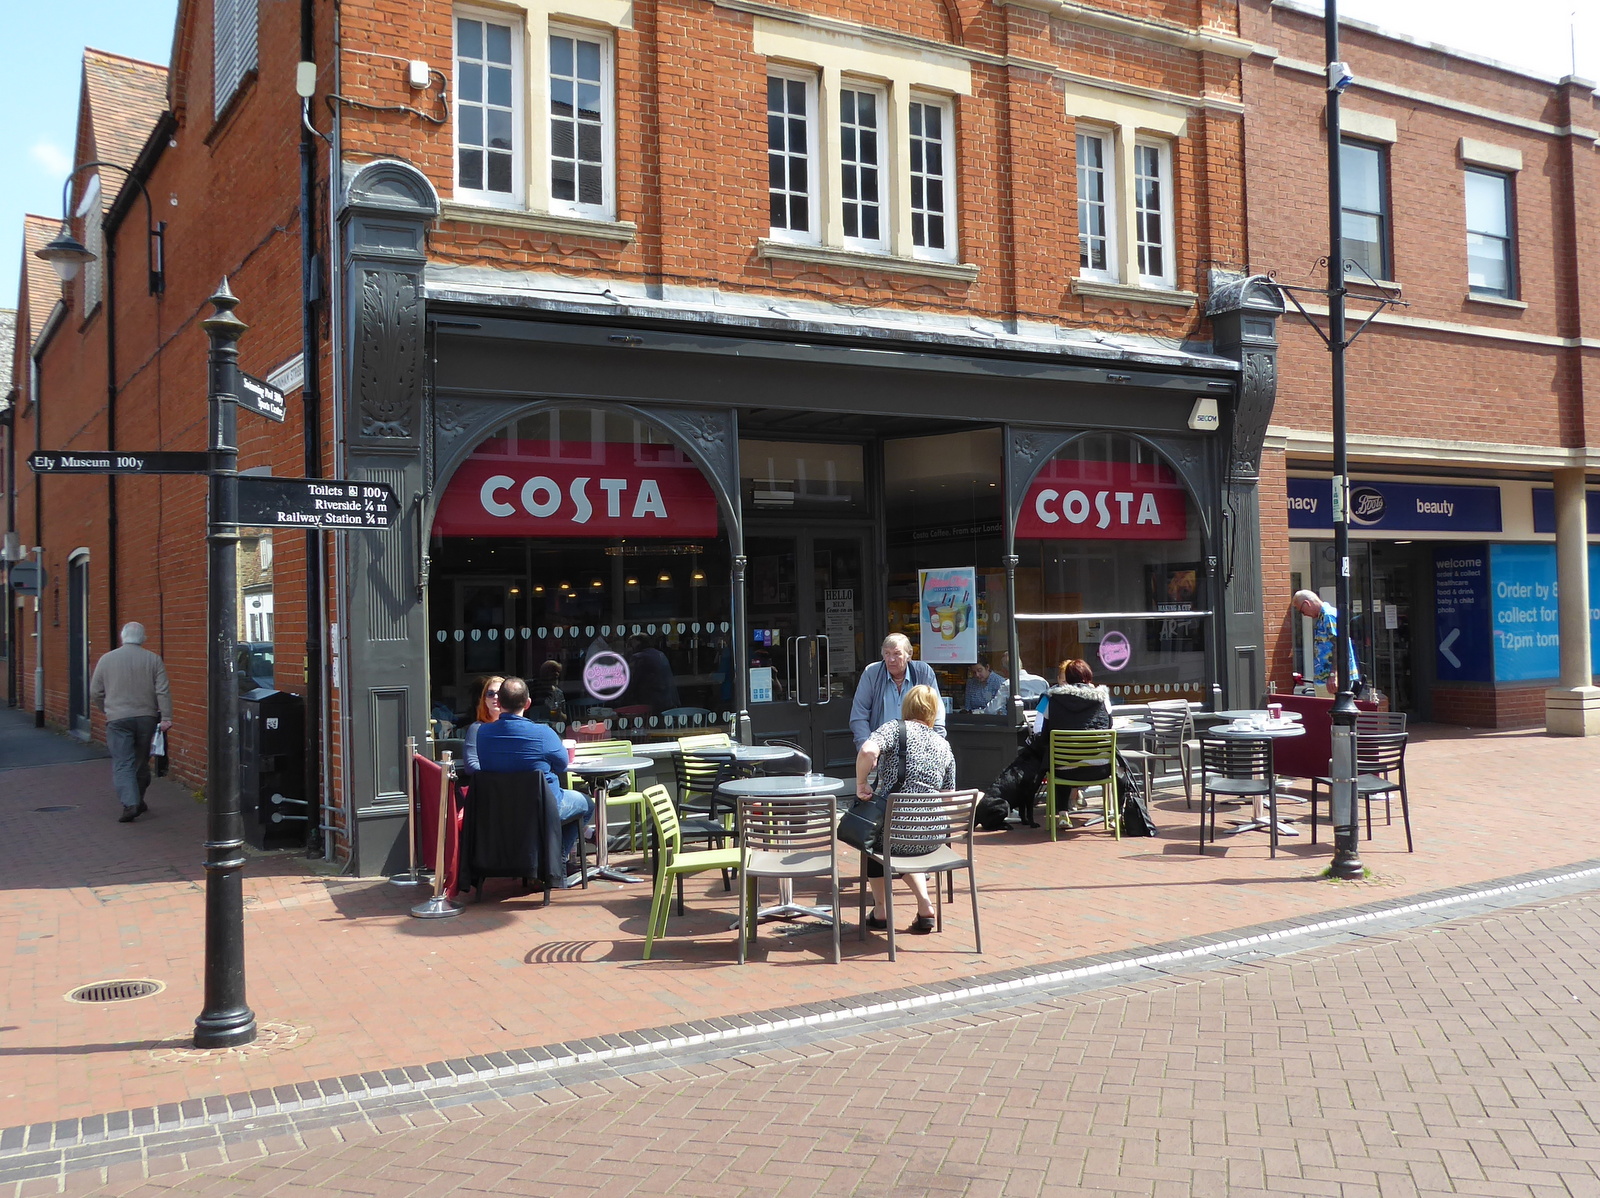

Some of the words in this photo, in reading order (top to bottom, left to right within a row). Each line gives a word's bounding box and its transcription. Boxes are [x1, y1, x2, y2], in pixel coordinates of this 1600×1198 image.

[34, 456, 55, 470] Ely
[61, 456, 110, 468] Museum
[117, 457, 144, 470] 100y
[308, 484, 343, 497] Toilets
[363, 486, 389, 501] 100y
[480, 475, 668, 524] COSTA
[315, 499, 361, 511] Riverside
[377, 503, 388, 512] m
[1035, 488, 1161, 530] COSTA
[1355, 494, 1384, 515] Boots
[1416, 498, 1454, 516] beauty
[278, 511, 321, 525] Railway
[325, 512, 362, 524] Station
[377, 516, 388, 525] m
[952, 527, 969, 536] From
[1436, 558, 1482, 568] welcome
[1460, 569, 1481, 577] collect
[826, 590, 852, 600] HELLO
[1497, 581, 1532, 598] Order
[1535, 582, 1549, 601] by
[1498, 606, 1538, 623] collect
[1540, 606, 1558, 622] for
[1159, 618, 1192, 641] ART
[1500, 633, 1534, 651] 12pm
